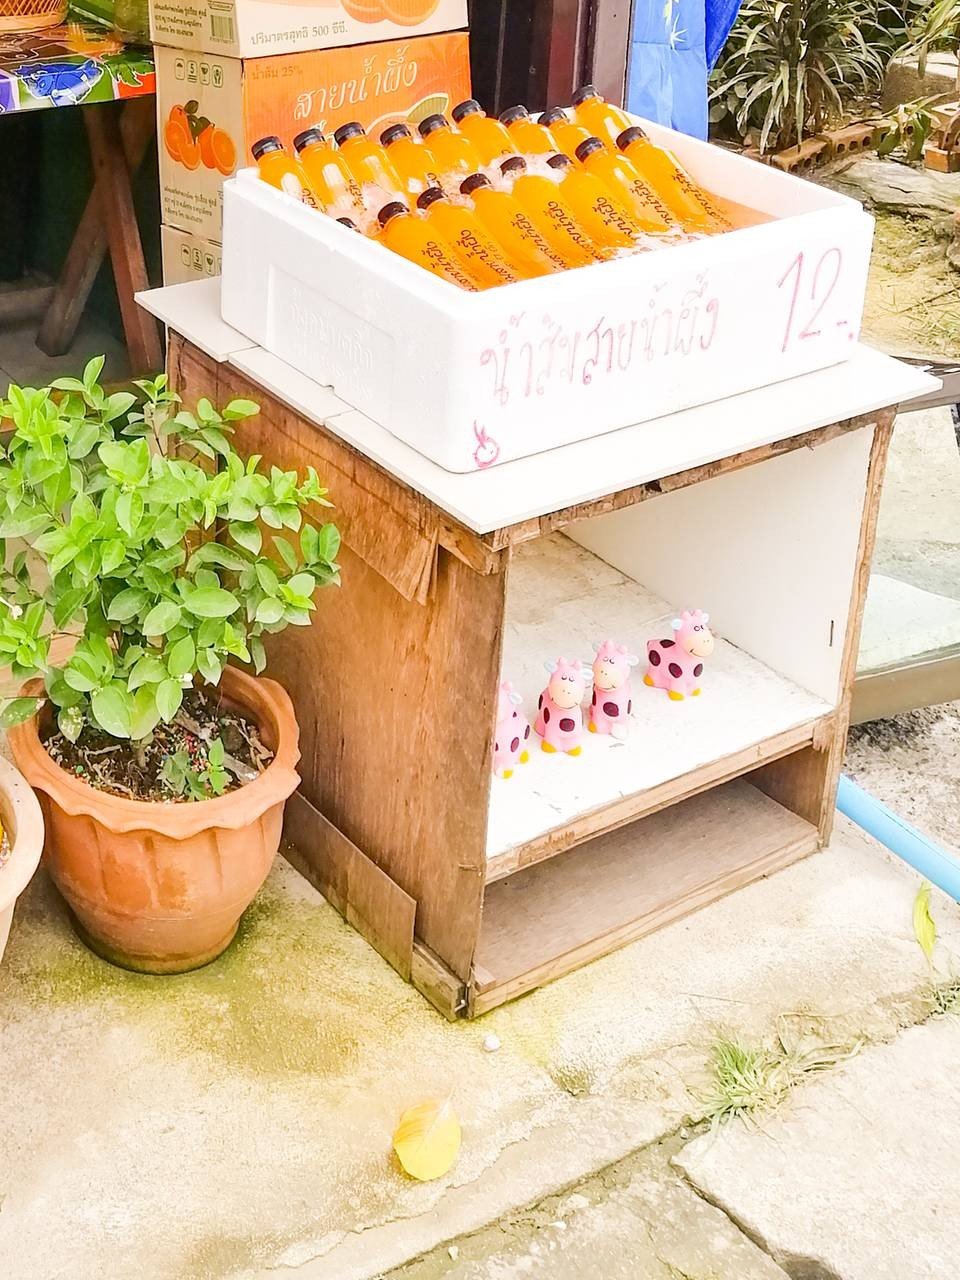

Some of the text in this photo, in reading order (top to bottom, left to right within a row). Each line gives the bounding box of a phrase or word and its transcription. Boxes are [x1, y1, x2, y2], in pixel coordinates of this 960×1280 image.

[251, 26, 308, 45] ปริมาตรสุทธิ
[312, 25, 329, 37] 500
[294, 45, 417, 121] สายน้ำผึ้ง
